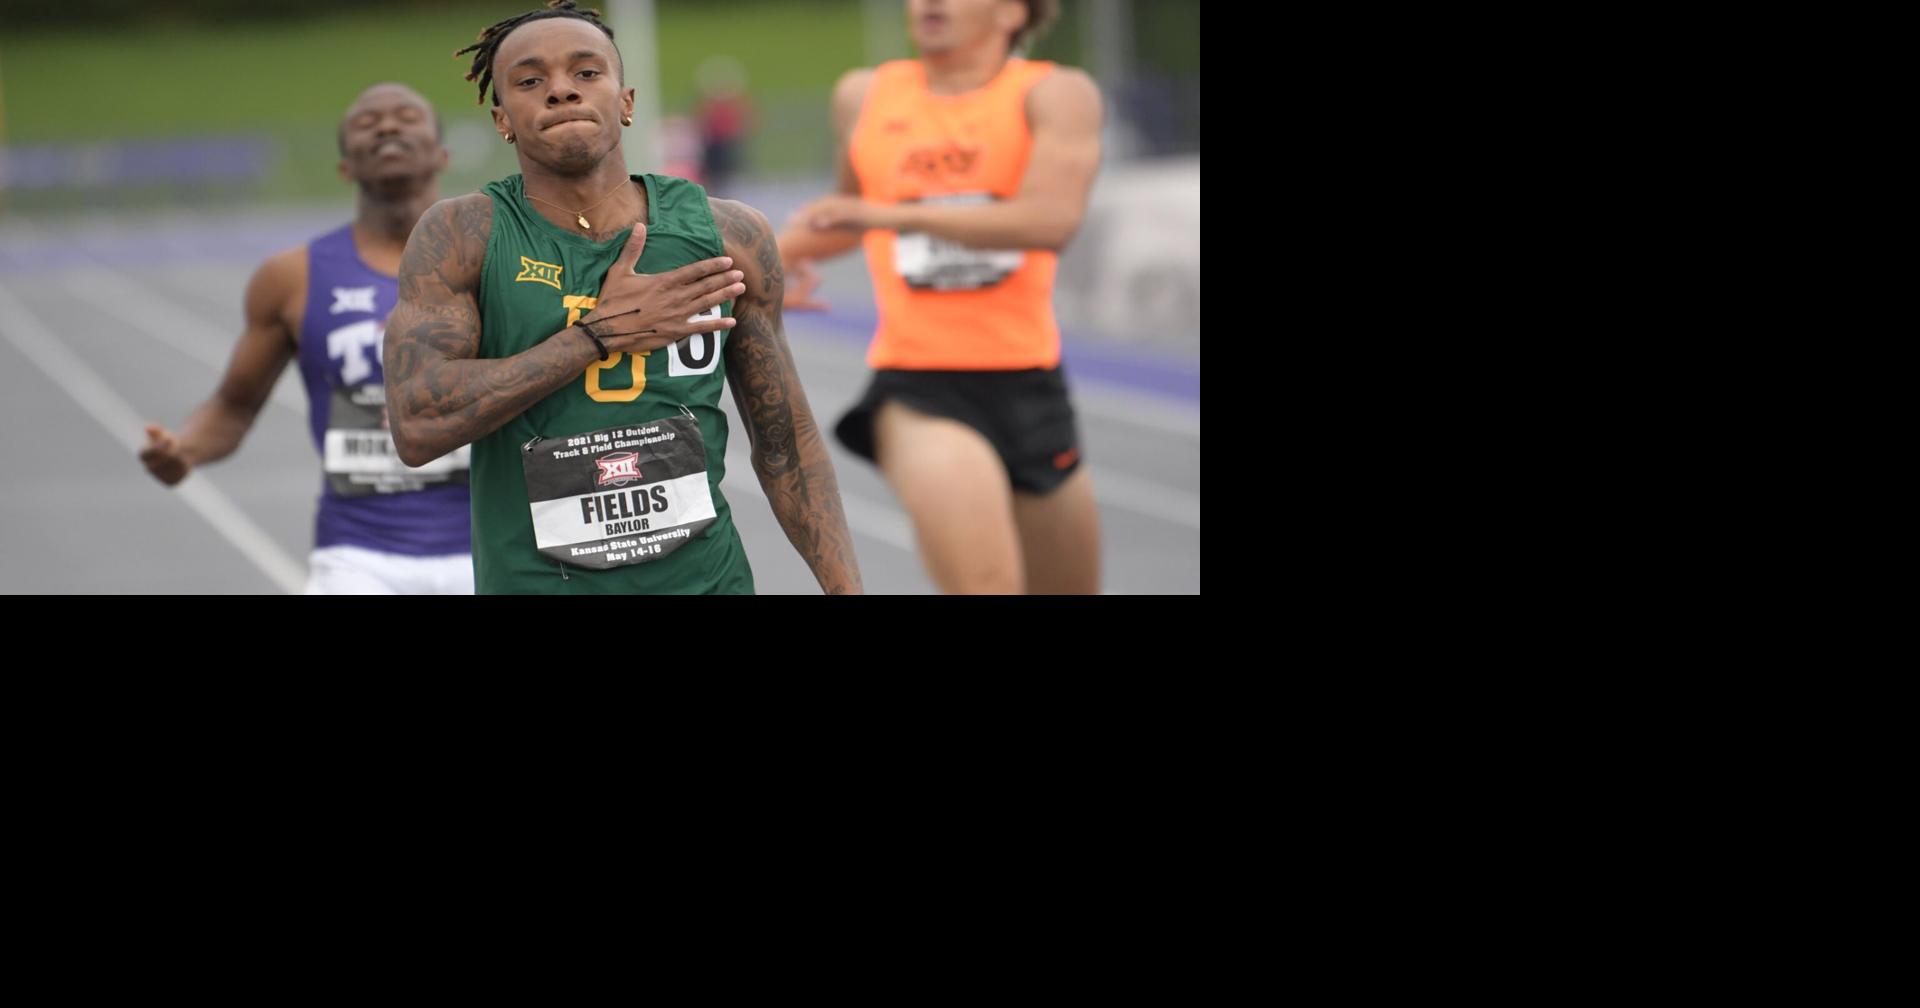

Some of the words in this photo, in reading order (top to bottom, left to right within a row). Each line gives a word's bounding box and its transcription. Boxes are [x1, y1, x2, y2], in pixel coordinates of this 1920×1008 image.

[553, 449, 581, 460] Track
[590, 441, 613, 454] Field
[614, 432, 676, 450] Championship
[567, 436, 592, 447] 2021
[594, 433, 609, 443] Big
[612, 430, 623, 439] 12
[626, 425, 660, 438] Outdoor
[580, 485, 669, 524] FIELDS
[605, 518, 650, 536] BAYLOR
[571, 541, 609, 557] Kansas
[609, 537, 637, 551] State
[639, 528, 691, 547] University
[606, 552, 628, 564] May
[630, 544, 662, 558] 14-16
